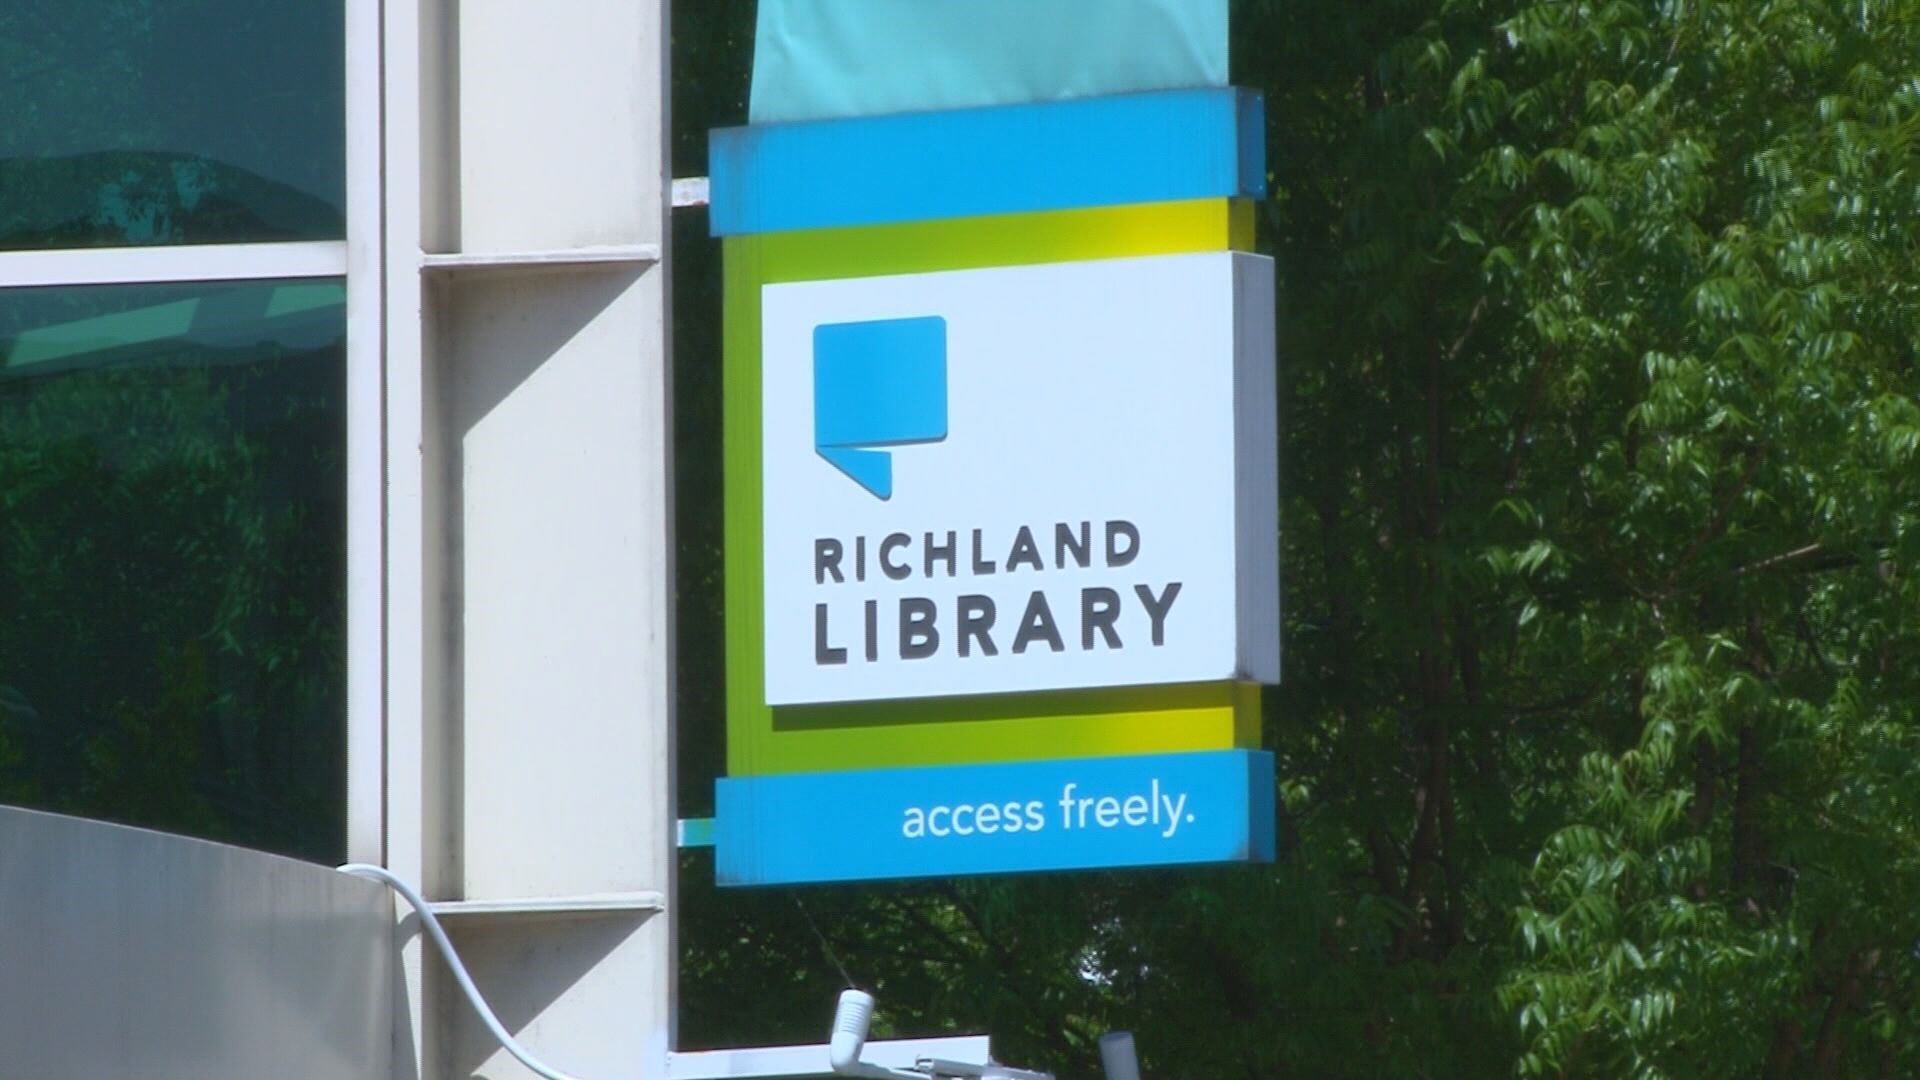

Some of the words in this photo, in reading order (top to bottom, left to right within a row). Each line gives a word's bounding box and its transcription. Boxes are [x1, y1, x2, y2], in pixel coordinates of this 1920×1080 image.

[814, 520, 1141, 585] RICHLAND
[815, 582, 1183, 665] LIBRARY
[902, 800, 1045, 838] access
[1059, 779, 1195, 838] freely.
